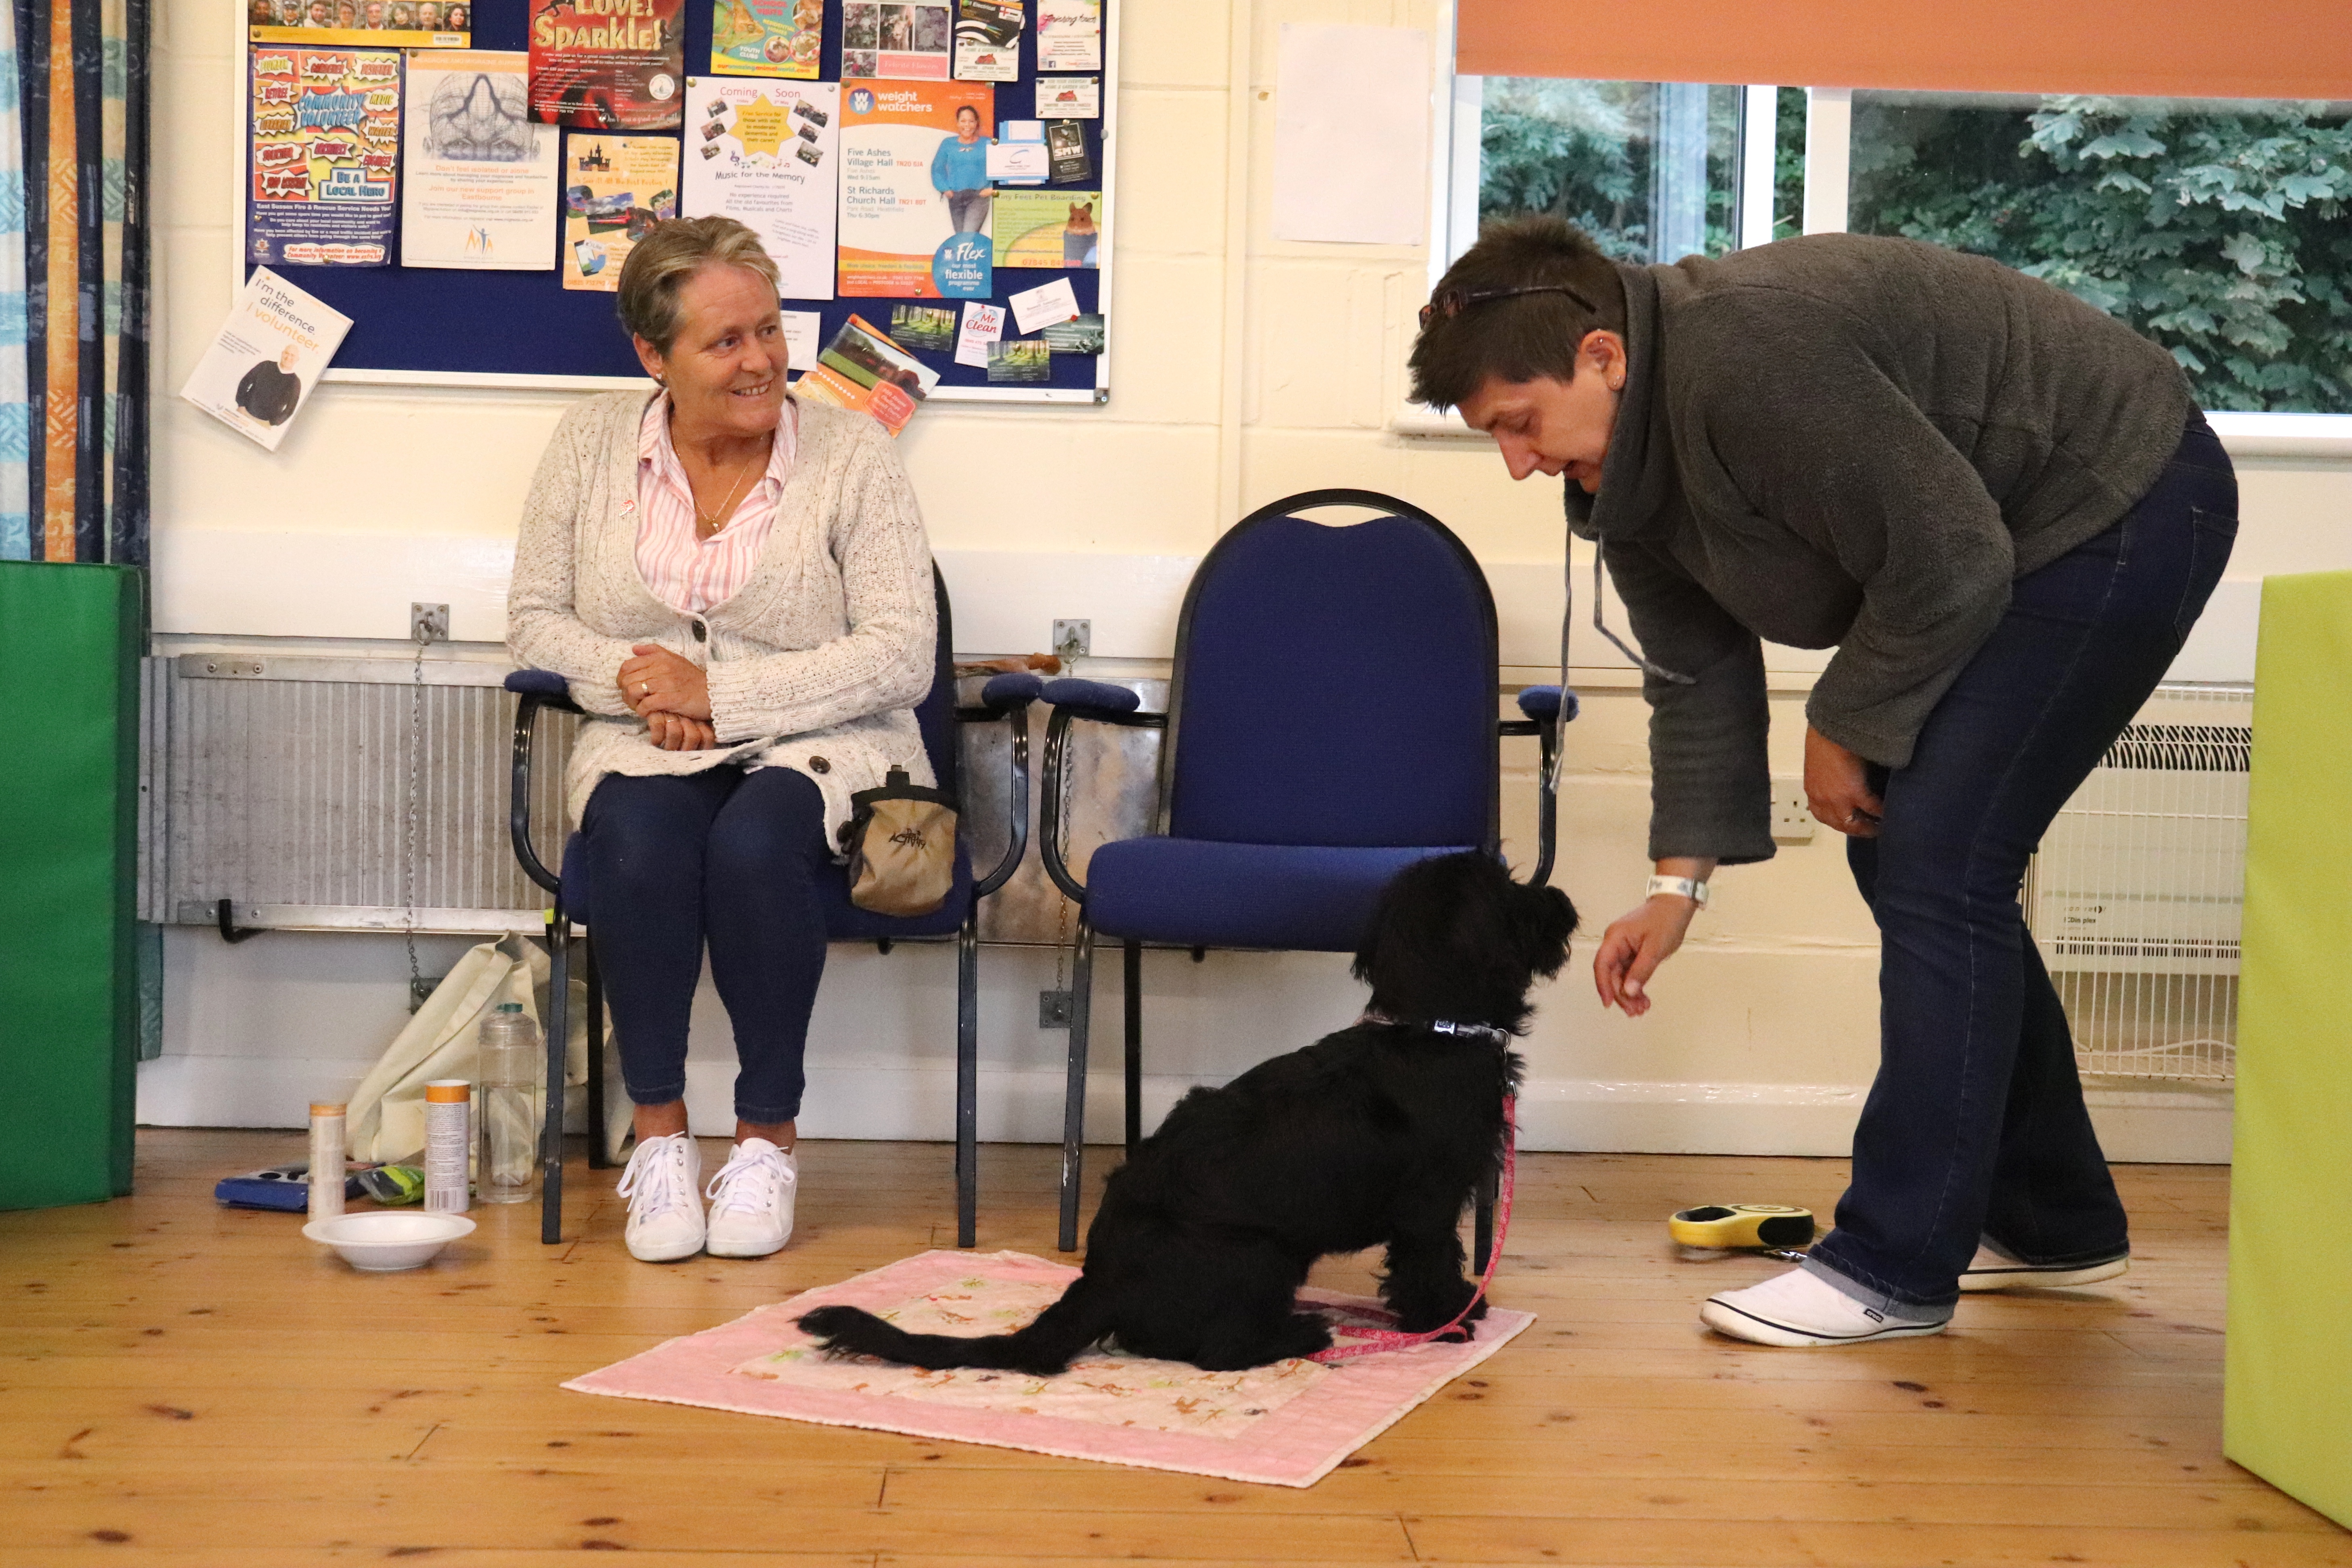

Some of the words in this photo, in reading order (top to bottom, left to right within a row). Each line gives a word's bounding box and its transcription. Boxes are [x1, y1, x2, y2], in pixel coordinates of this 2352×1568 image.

[721, 87, 757, 98] Coming
[776, 88, 801, 98] Soon
[878, 91, 917, 103] weight
[298, 93, 365, 111] COMMUNITY
[370, 94, 394, 105] MEDIC
[878, 102, 933, 112] watchers
[301, 108, 361, 126] VOLUNTEER
[1054, 145, 1082, 157] SMW
[847, 158, 874, 168] Village
[715, 171, 738, 180] Music
[772, 172, 805, 185] Memory
[327, 184, 356, 196] LOCAL
[359, 185, 385, 197] HERO
[957, 241, 986, 262] Flex
[945, 269, 983, 280] flexible
[255, 278, 274, 295] I'm
[275, 290, 295, 308] the
[260, 296, 316, 335] difference.
[981, 313, 996, 323] Mr
[255, 310, 320, 355] volunteer.
[966, 319, 997, 333] Clean
